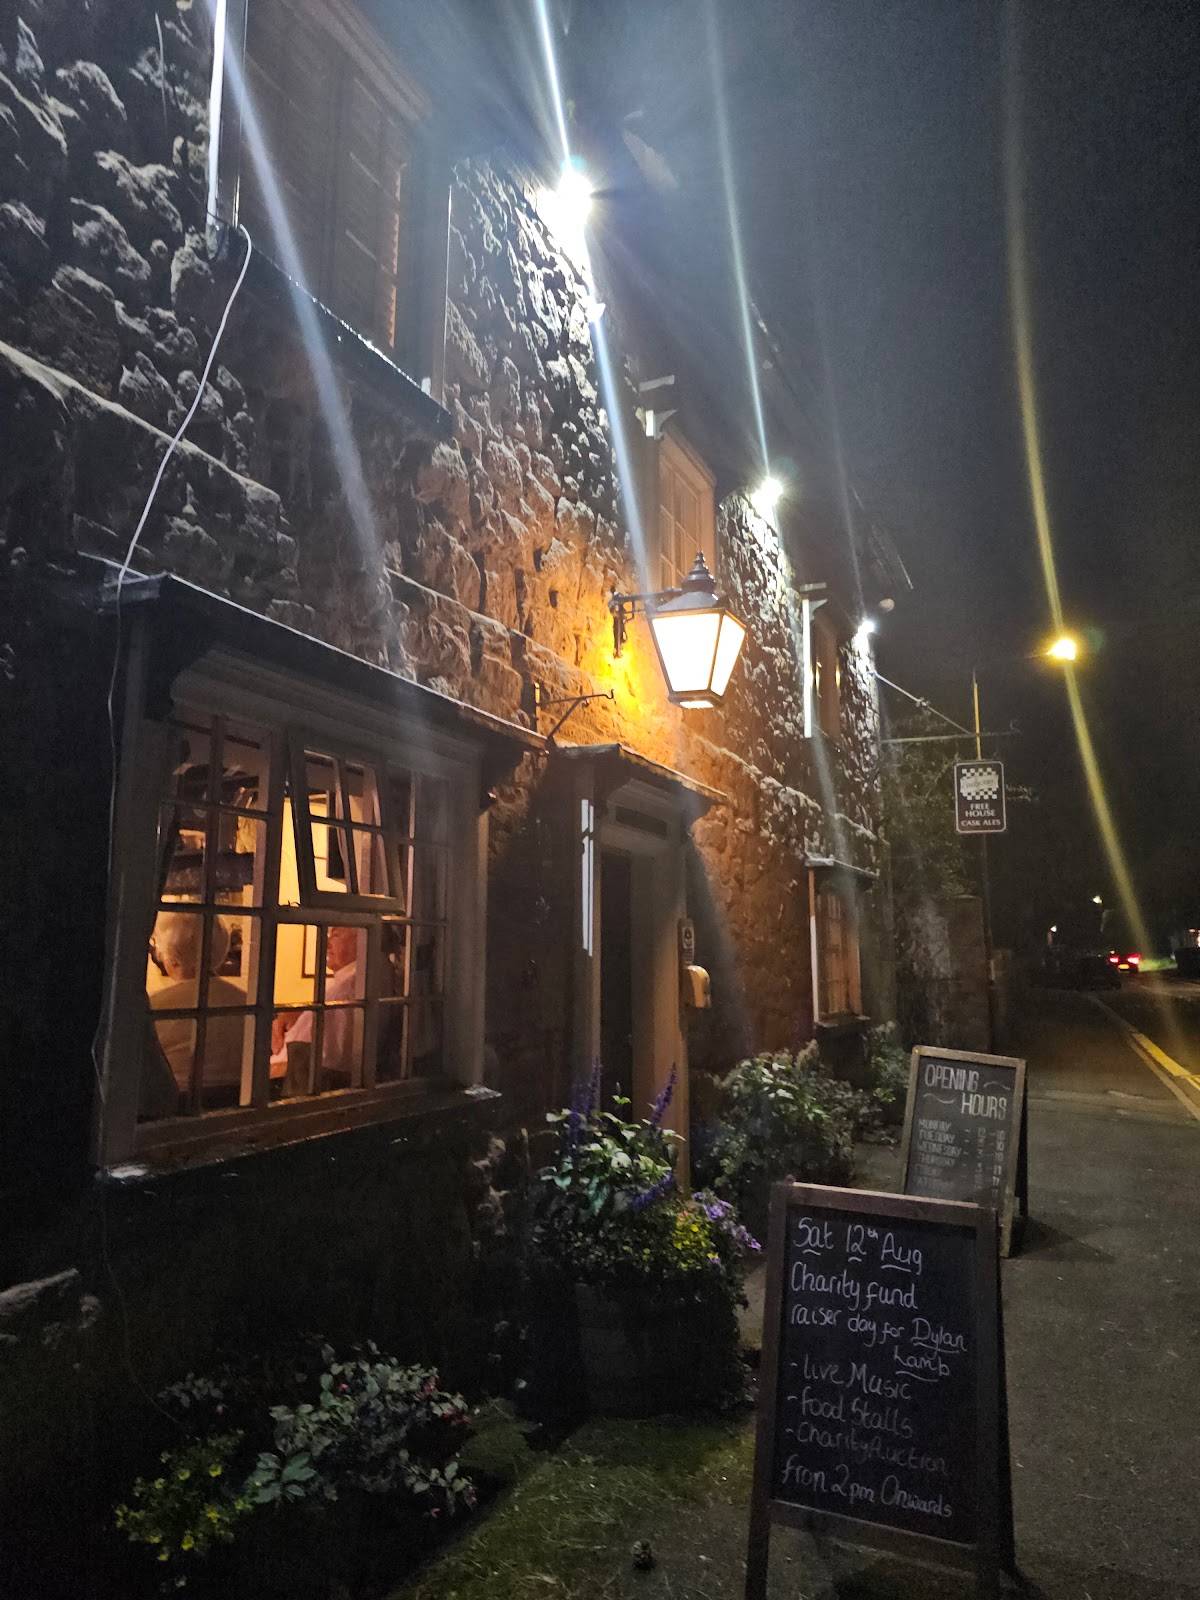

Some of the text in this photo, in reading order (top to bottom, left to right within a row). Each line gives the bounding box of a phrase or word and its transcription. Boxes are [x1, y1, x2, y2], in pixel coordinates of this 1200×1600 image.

[965, 809, 996, 817] HOUSE
[924, 1064, 980, 1093] OPENING
[961, 1092, 1007, 1120] HOURS
[793, 1216, 922, 1275] Sat 12th Aug
[791, 1261, 919, 1312] Charity fund
[791, 1303, 968, 1359] raiser day for Dylan
[846, 1362, 912, 1400] Music
[851, 1397, 913, 1439] Stalls
[880, 1474, 953, 1518] Onwards
